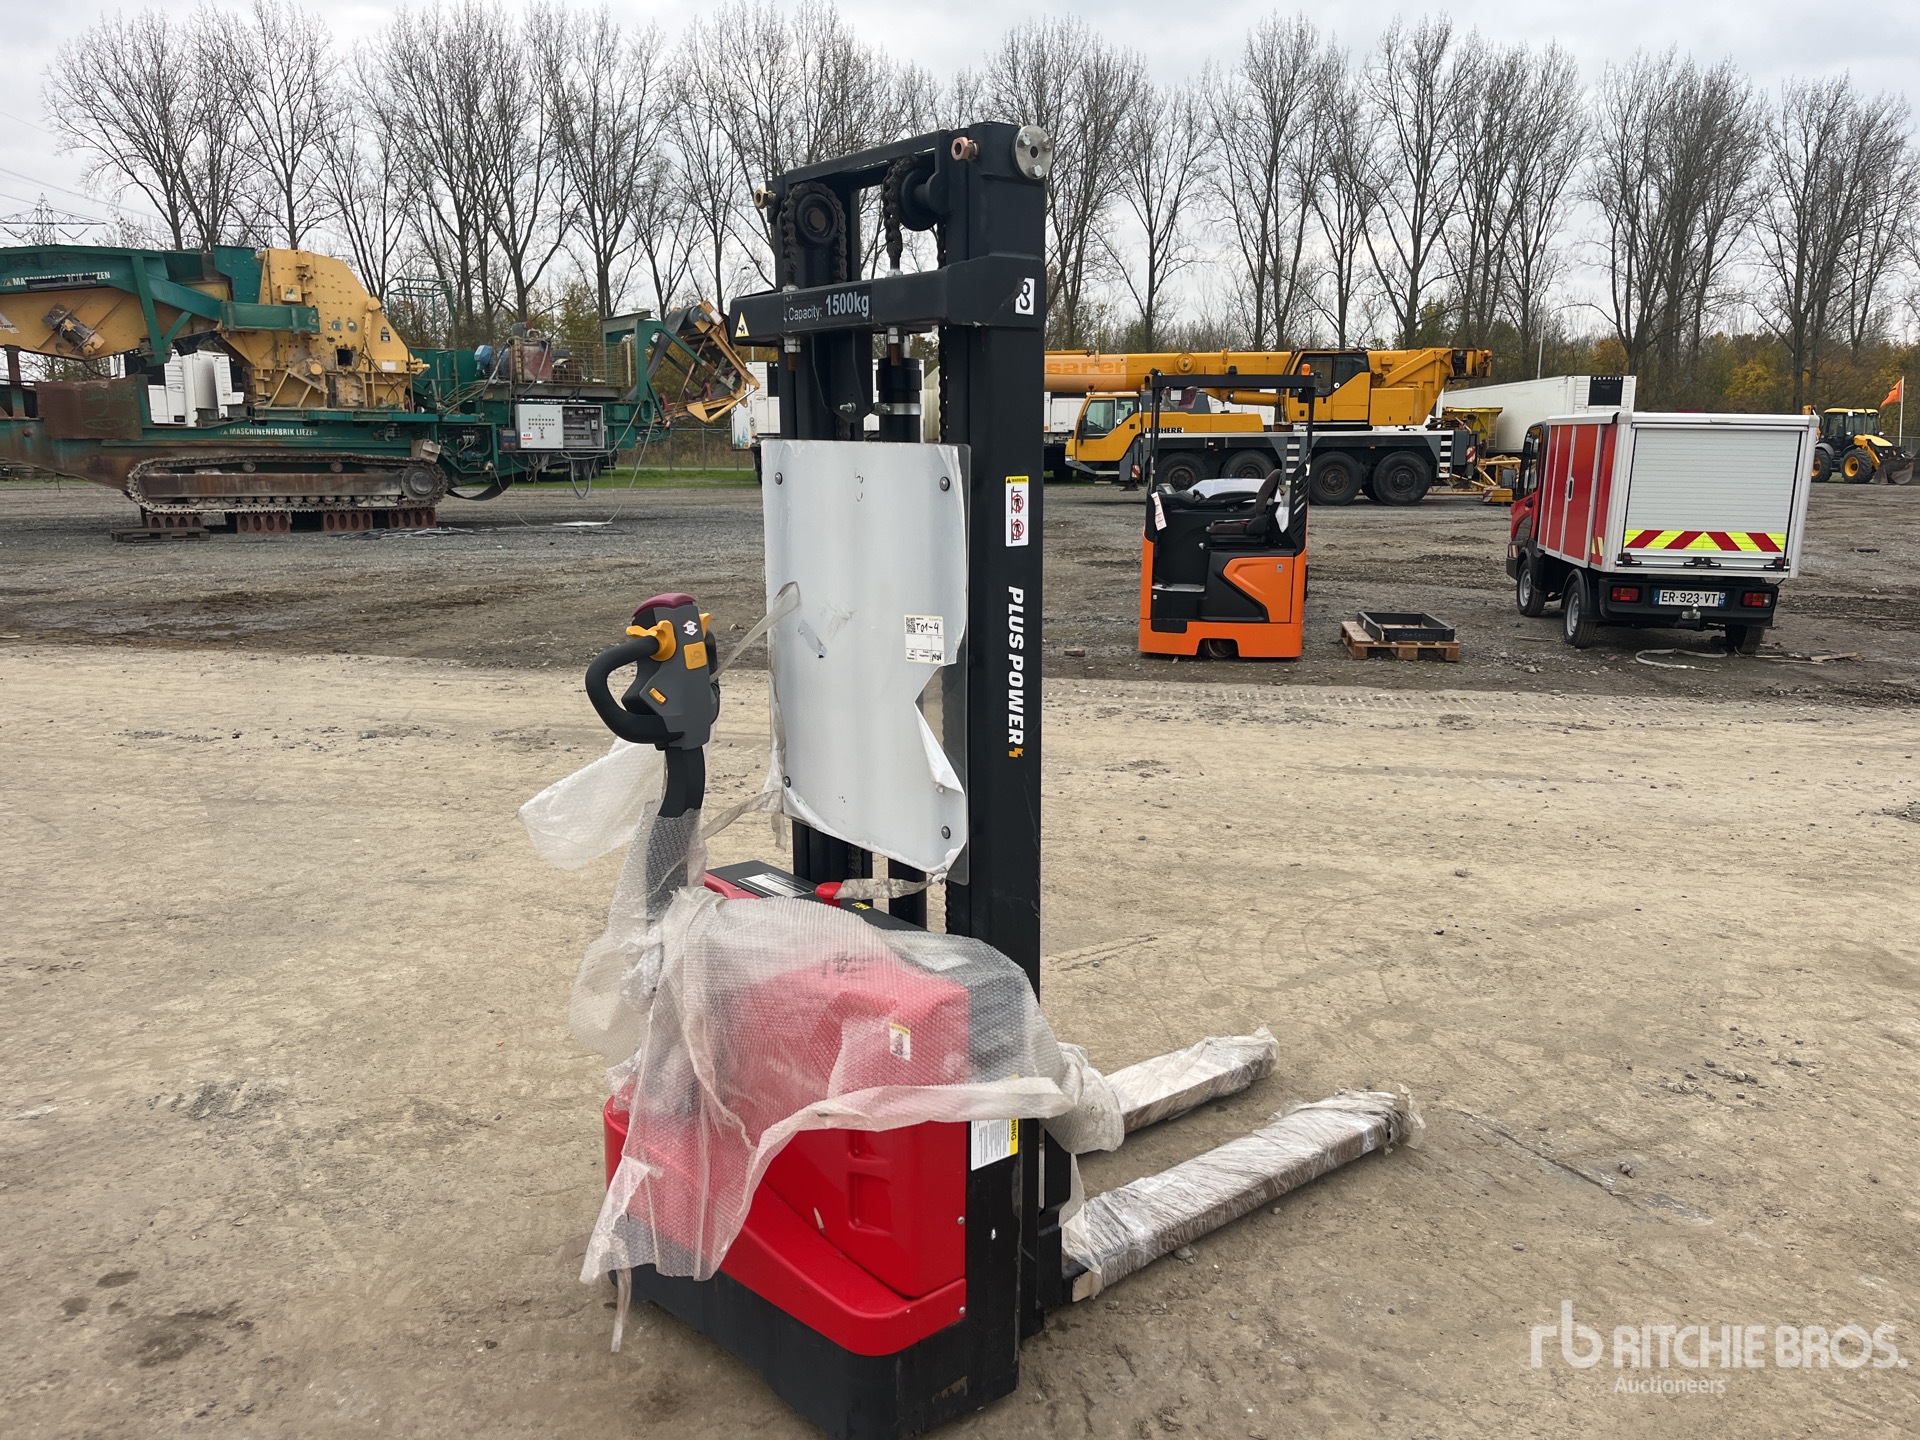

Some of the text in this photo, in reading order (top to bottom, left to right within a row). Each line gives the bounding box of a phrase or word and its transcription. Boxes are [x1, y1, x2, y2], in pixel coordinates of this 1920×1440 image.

[788, 291, 870, 322] Capacity: 1500kg
[229, 427, 295, 436] MASCHINENFABRIK
[1661, 591, 1718, 604] ER-923-VT
[1008, 585, 1024, 745] PLUS POWER
[1010, 1119, 1018, 1142] NING
